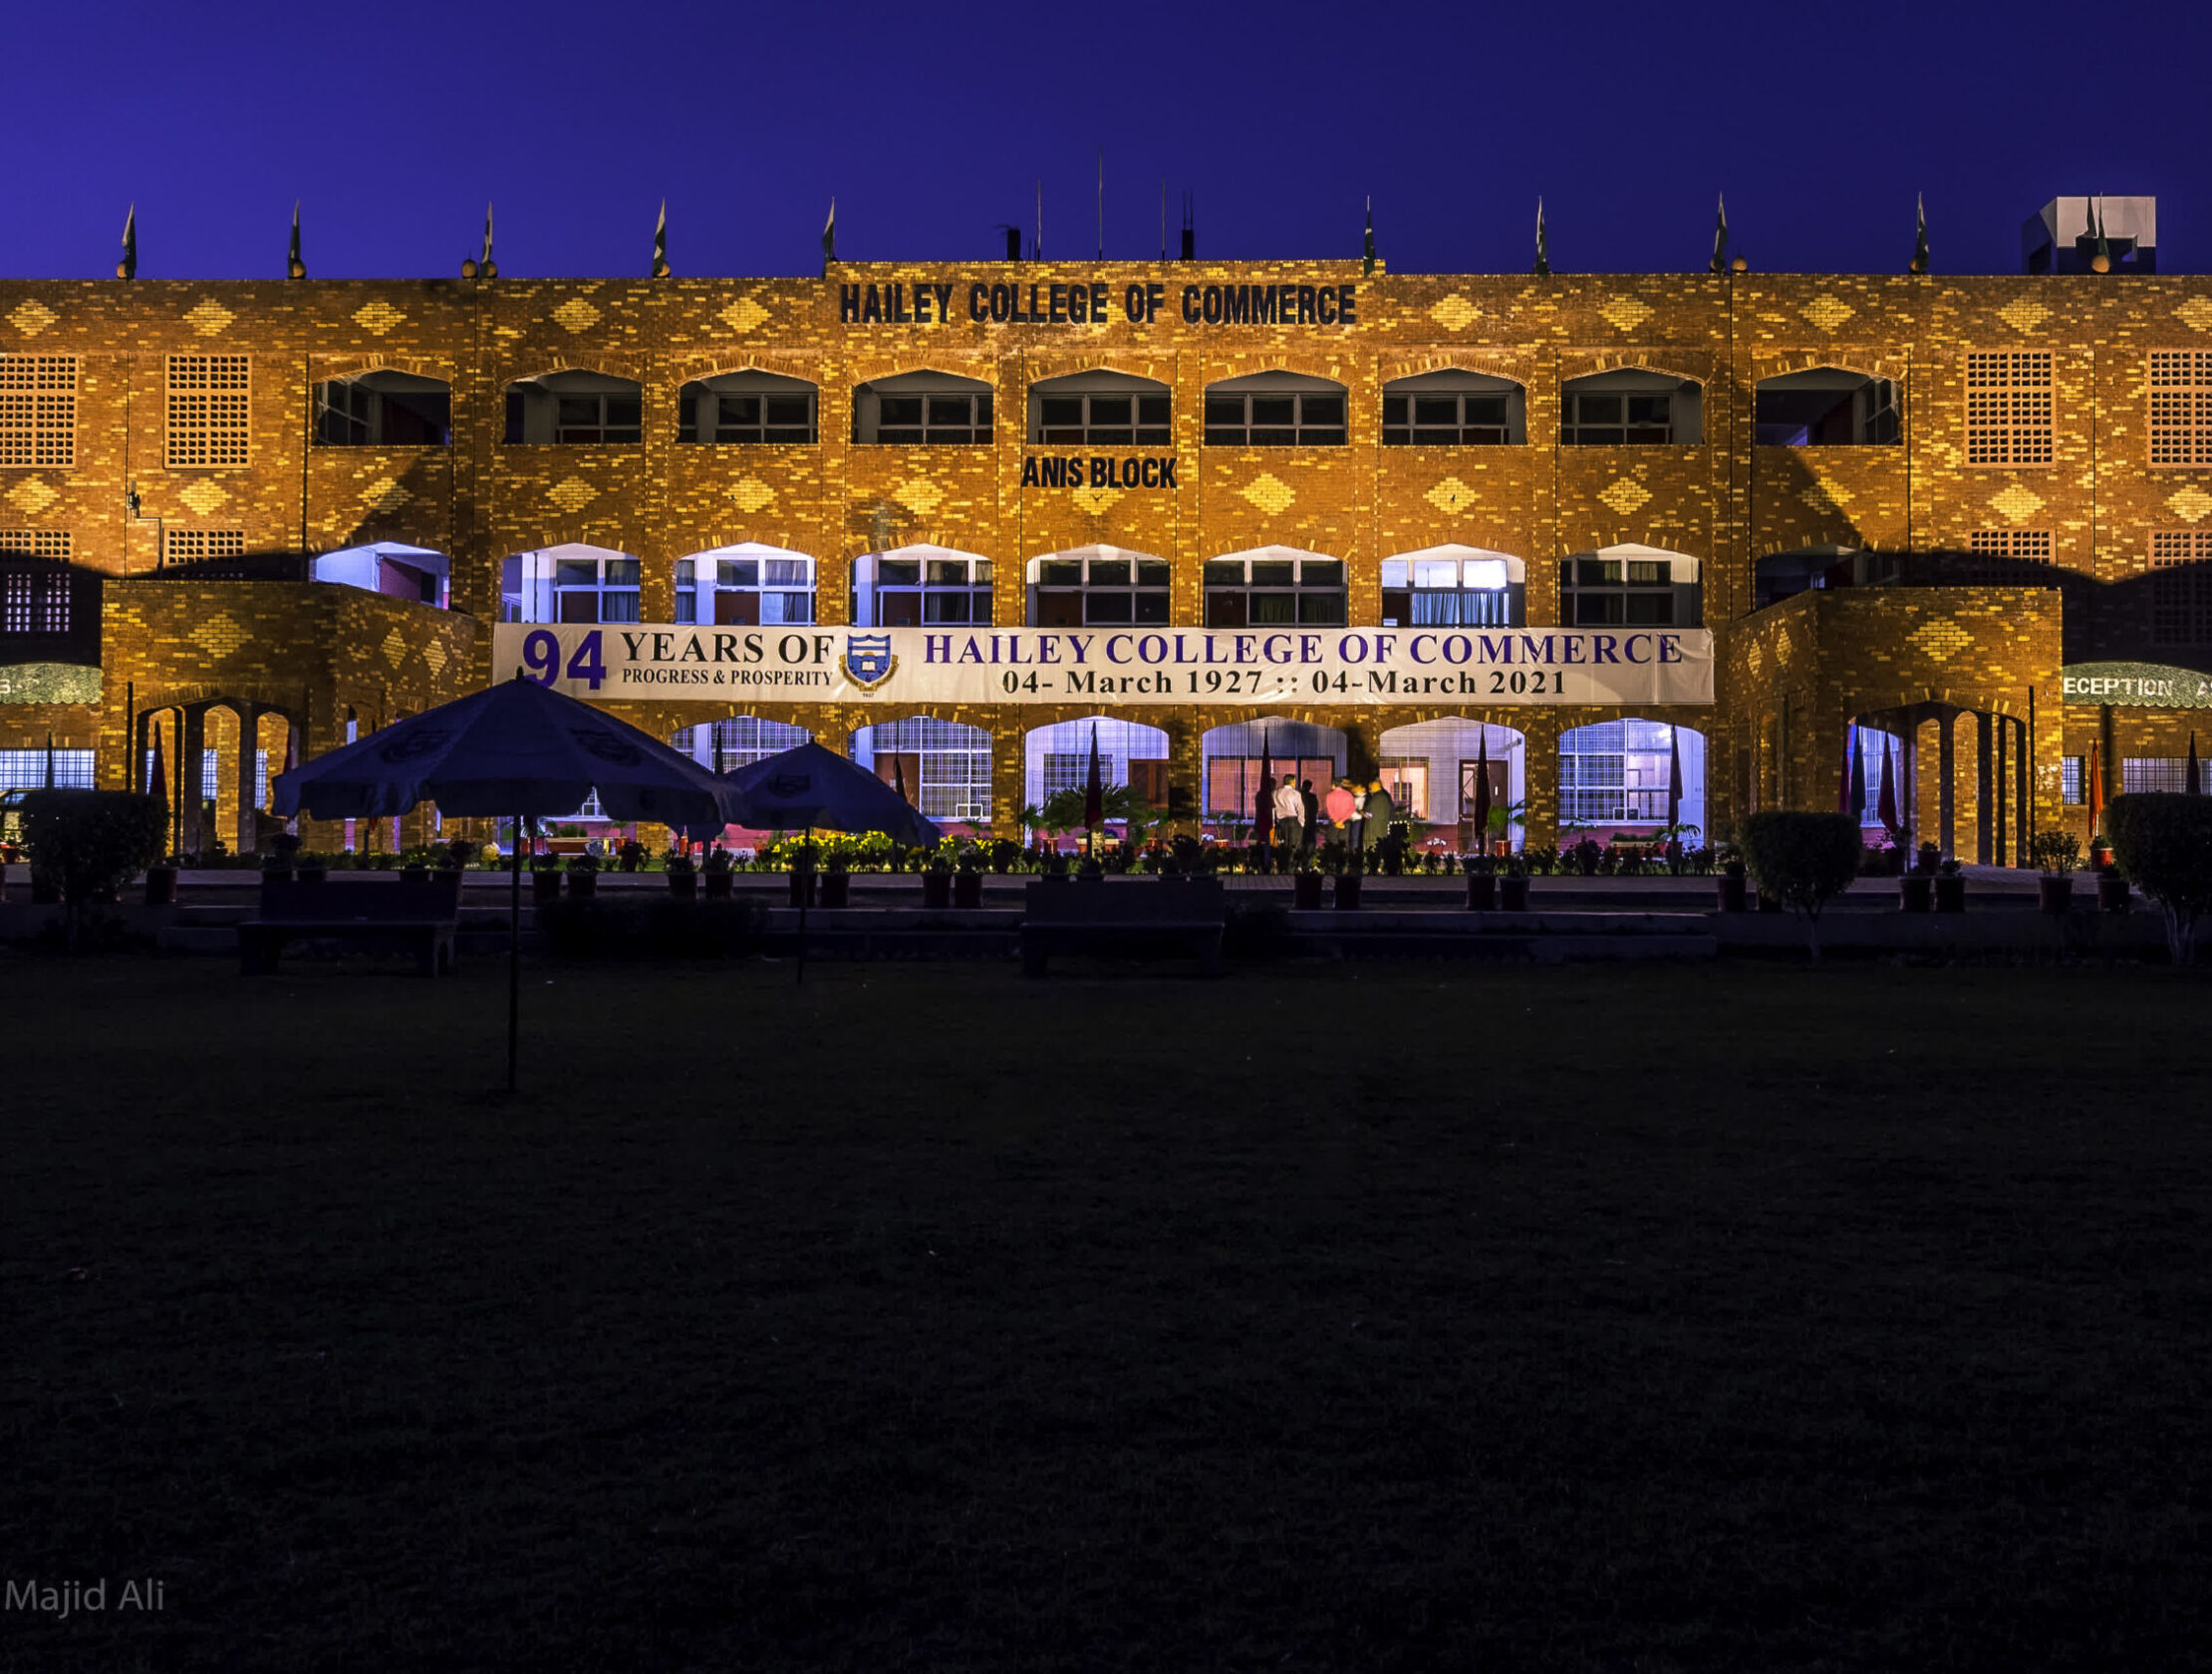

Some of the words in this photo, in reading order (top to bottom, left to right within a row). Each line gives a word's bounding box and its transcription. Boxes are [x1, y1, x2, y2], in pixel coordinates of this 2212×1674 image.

[840, 283, 954, 324] HAILEY
[968, 283, 1108, 324] COLLEGE
[1125, 284, 1165, 324] OF
[1182, 284, 1356, 325] COMMERCE
[1021, 457, 1084, 488] ANIS
[1091, 457, 1177, 489] BLOCK
[522, 629, 607, 690] 94
[620, 632, 764, 664] YEARS
[777, 634, 835, 665] OF
[924, 634, 1095, 665] HAILEY
[1105, 634, 1323, 665] COLLEGE
[1338, 634, 1397, 665] OF
[1409, 634, 1684, 665] COMMERCE
[622, 669, 708, 685] PROGRESS
[713, 670, 725, 685] &
[730, 670, 833, 686] PROSPERITY
[1002, 670, 1053, 694] 04-
[1065, 670, 1173, 694] March
[1188, 670, 1262, 694] 1927
[1311, 670, 1477, 695] 04-March
[1489, 670, 1566, 695] 2021
[2063, 677, 2173, 697] ECEPTION
